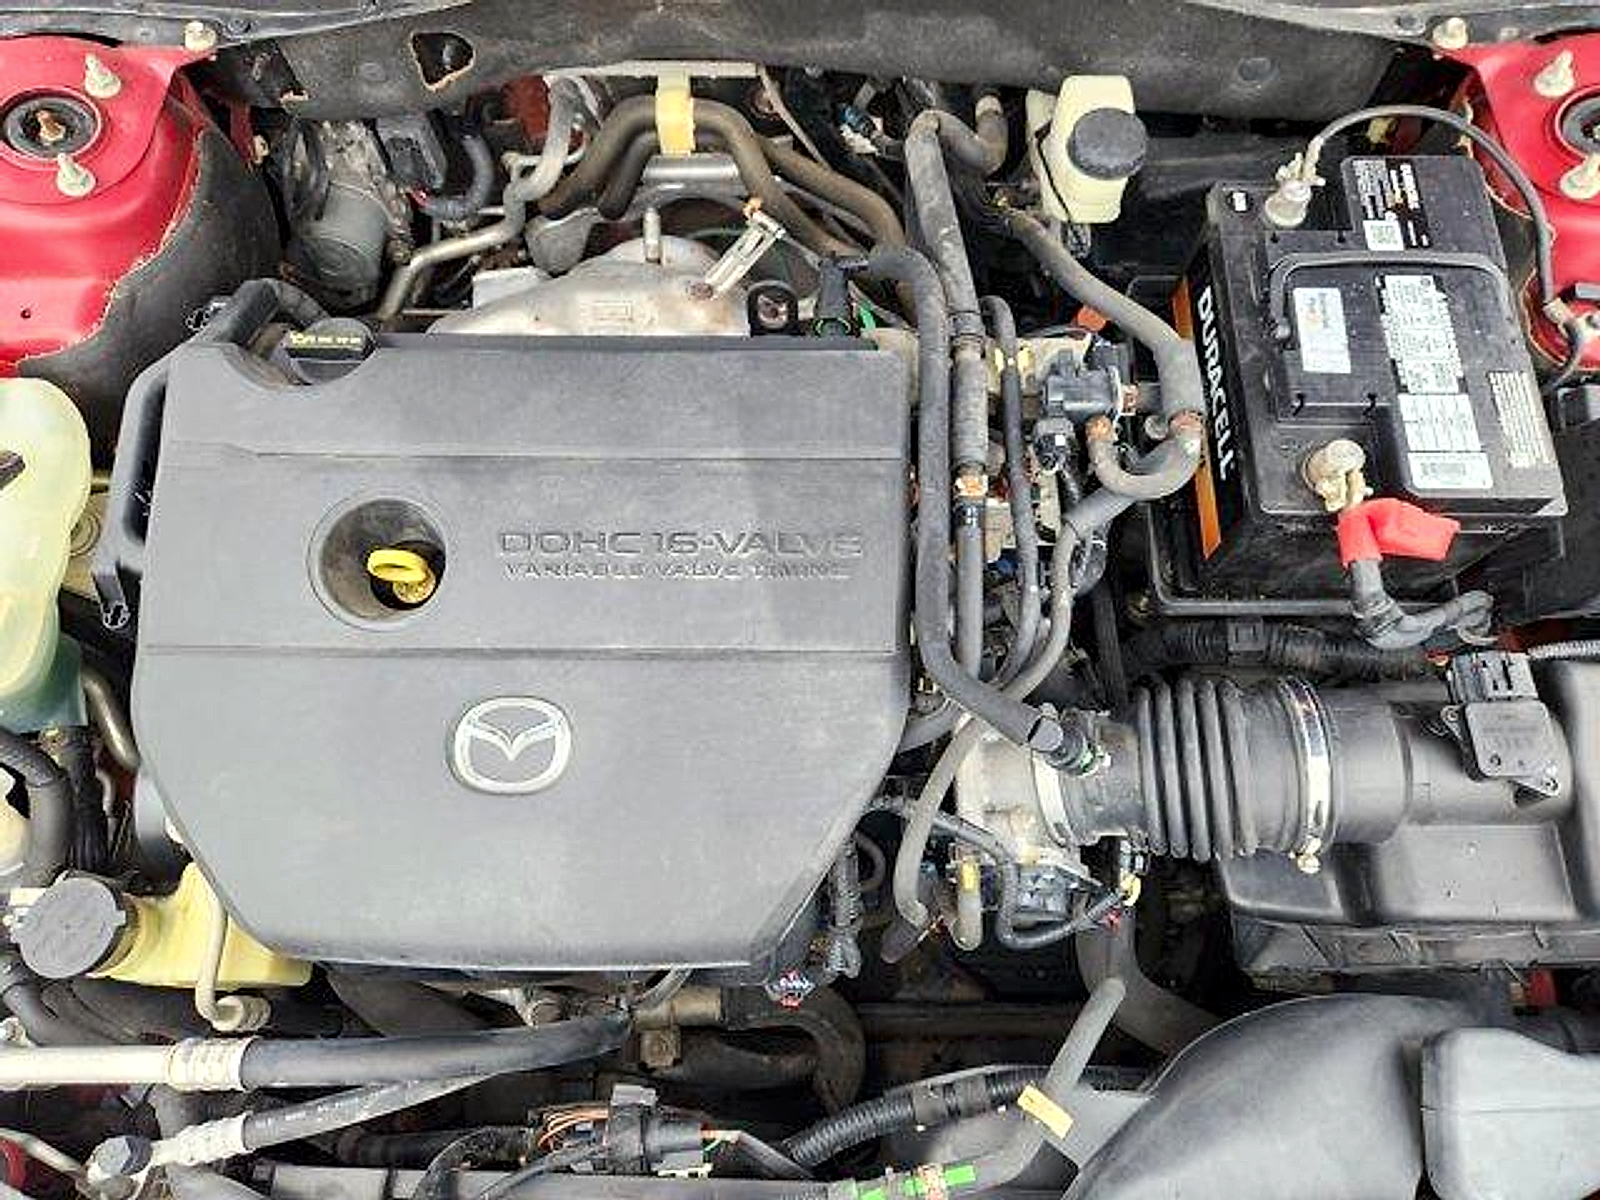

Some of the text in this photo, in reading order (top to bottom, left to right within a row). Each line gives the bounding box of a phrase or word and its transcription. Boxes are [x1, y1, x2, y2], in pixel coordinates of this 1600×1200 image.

[1198, 285, 1234, 481] DURACELL
[499, 531, 862, 556] DOHC 16-VALVE
[655, 562, 742, 580] VALVE
